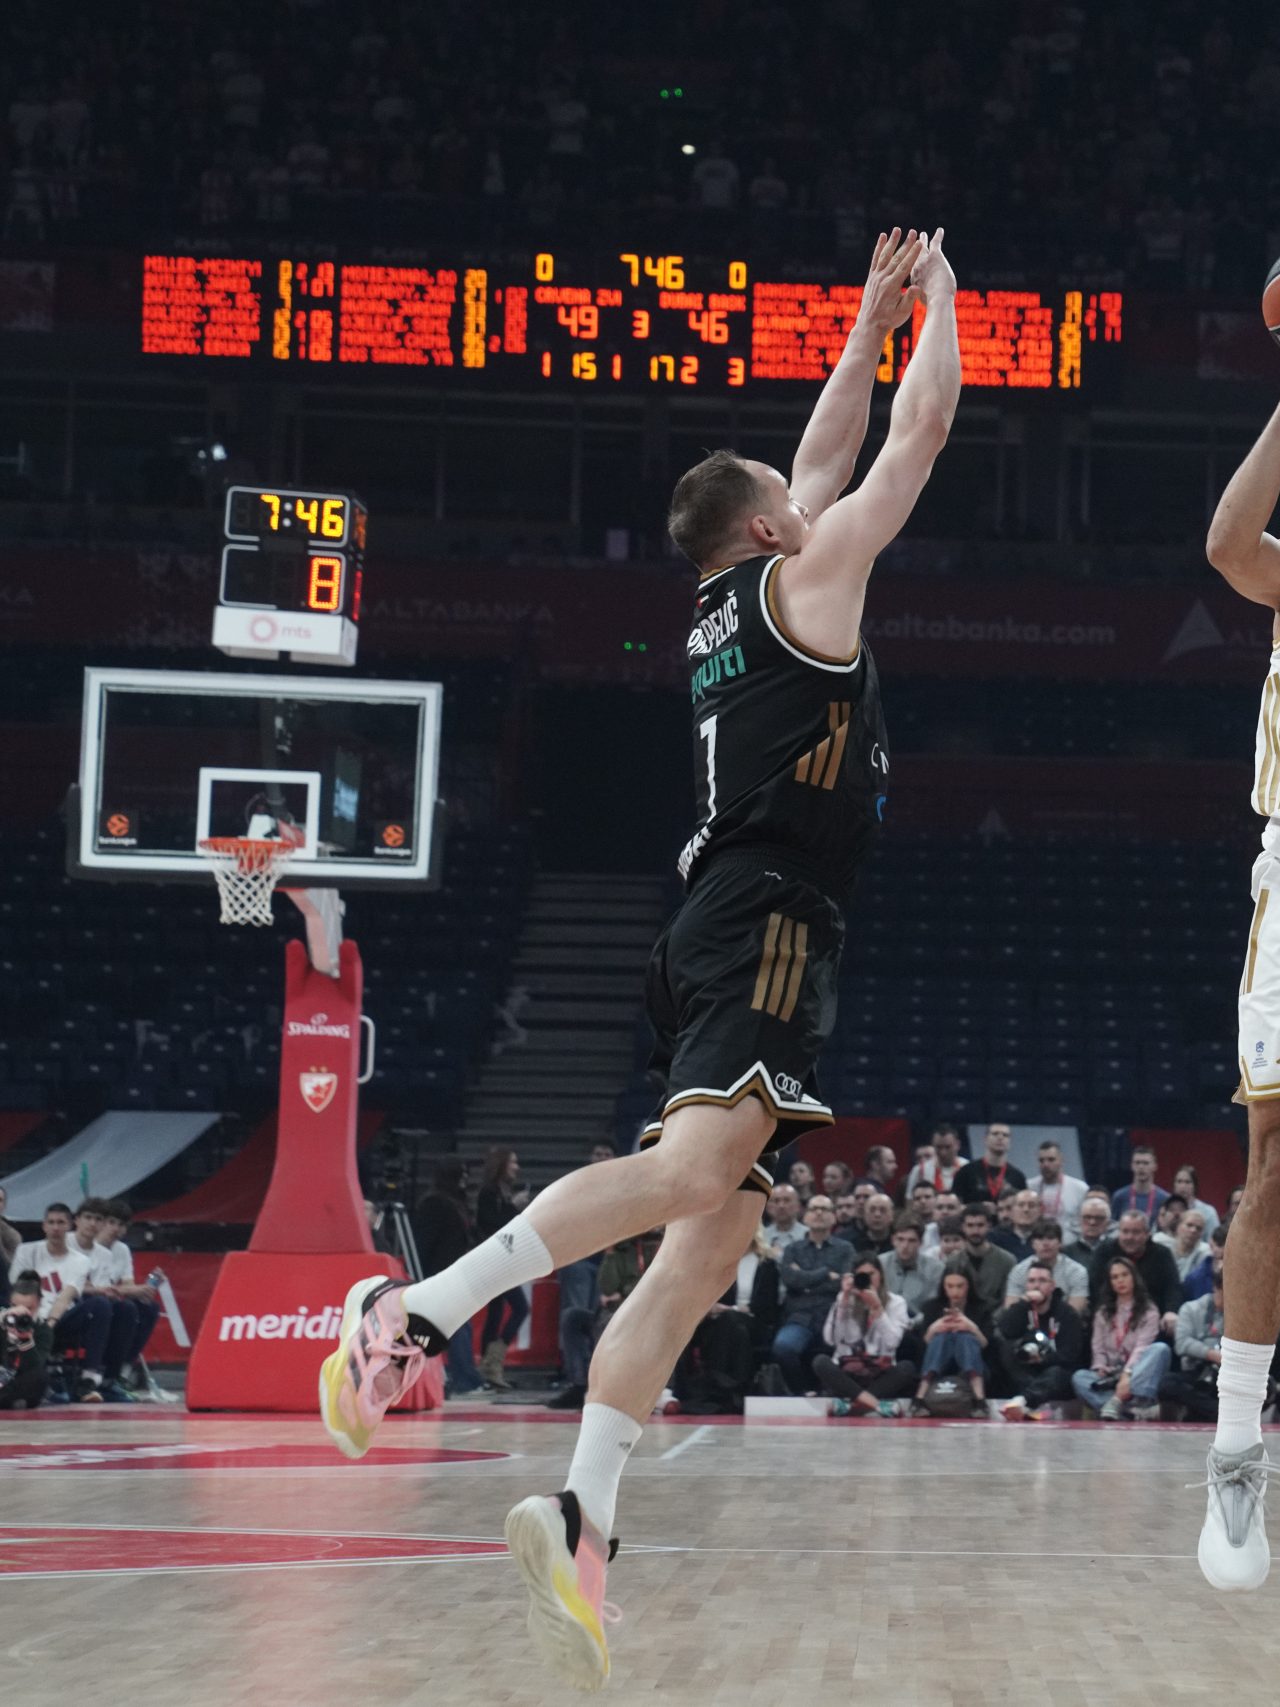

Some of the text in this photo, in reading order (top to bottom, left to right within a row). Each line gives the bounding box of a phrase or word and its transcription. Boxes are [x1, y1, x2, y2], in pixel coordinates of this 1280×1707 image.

[558, 305, 599, 339] 49
[632, 309, 650, 339] 3
[688, 310, 729, 344] 46
[542, 352, 745, 386] 1 15 1 17 2 3
[260, 493, 344, 538] 7:46
[308, 556, 341, 611] 8
[288, 1021, 350, 1039] SPALDING
[218, 1306, 343, 1341] meridi
